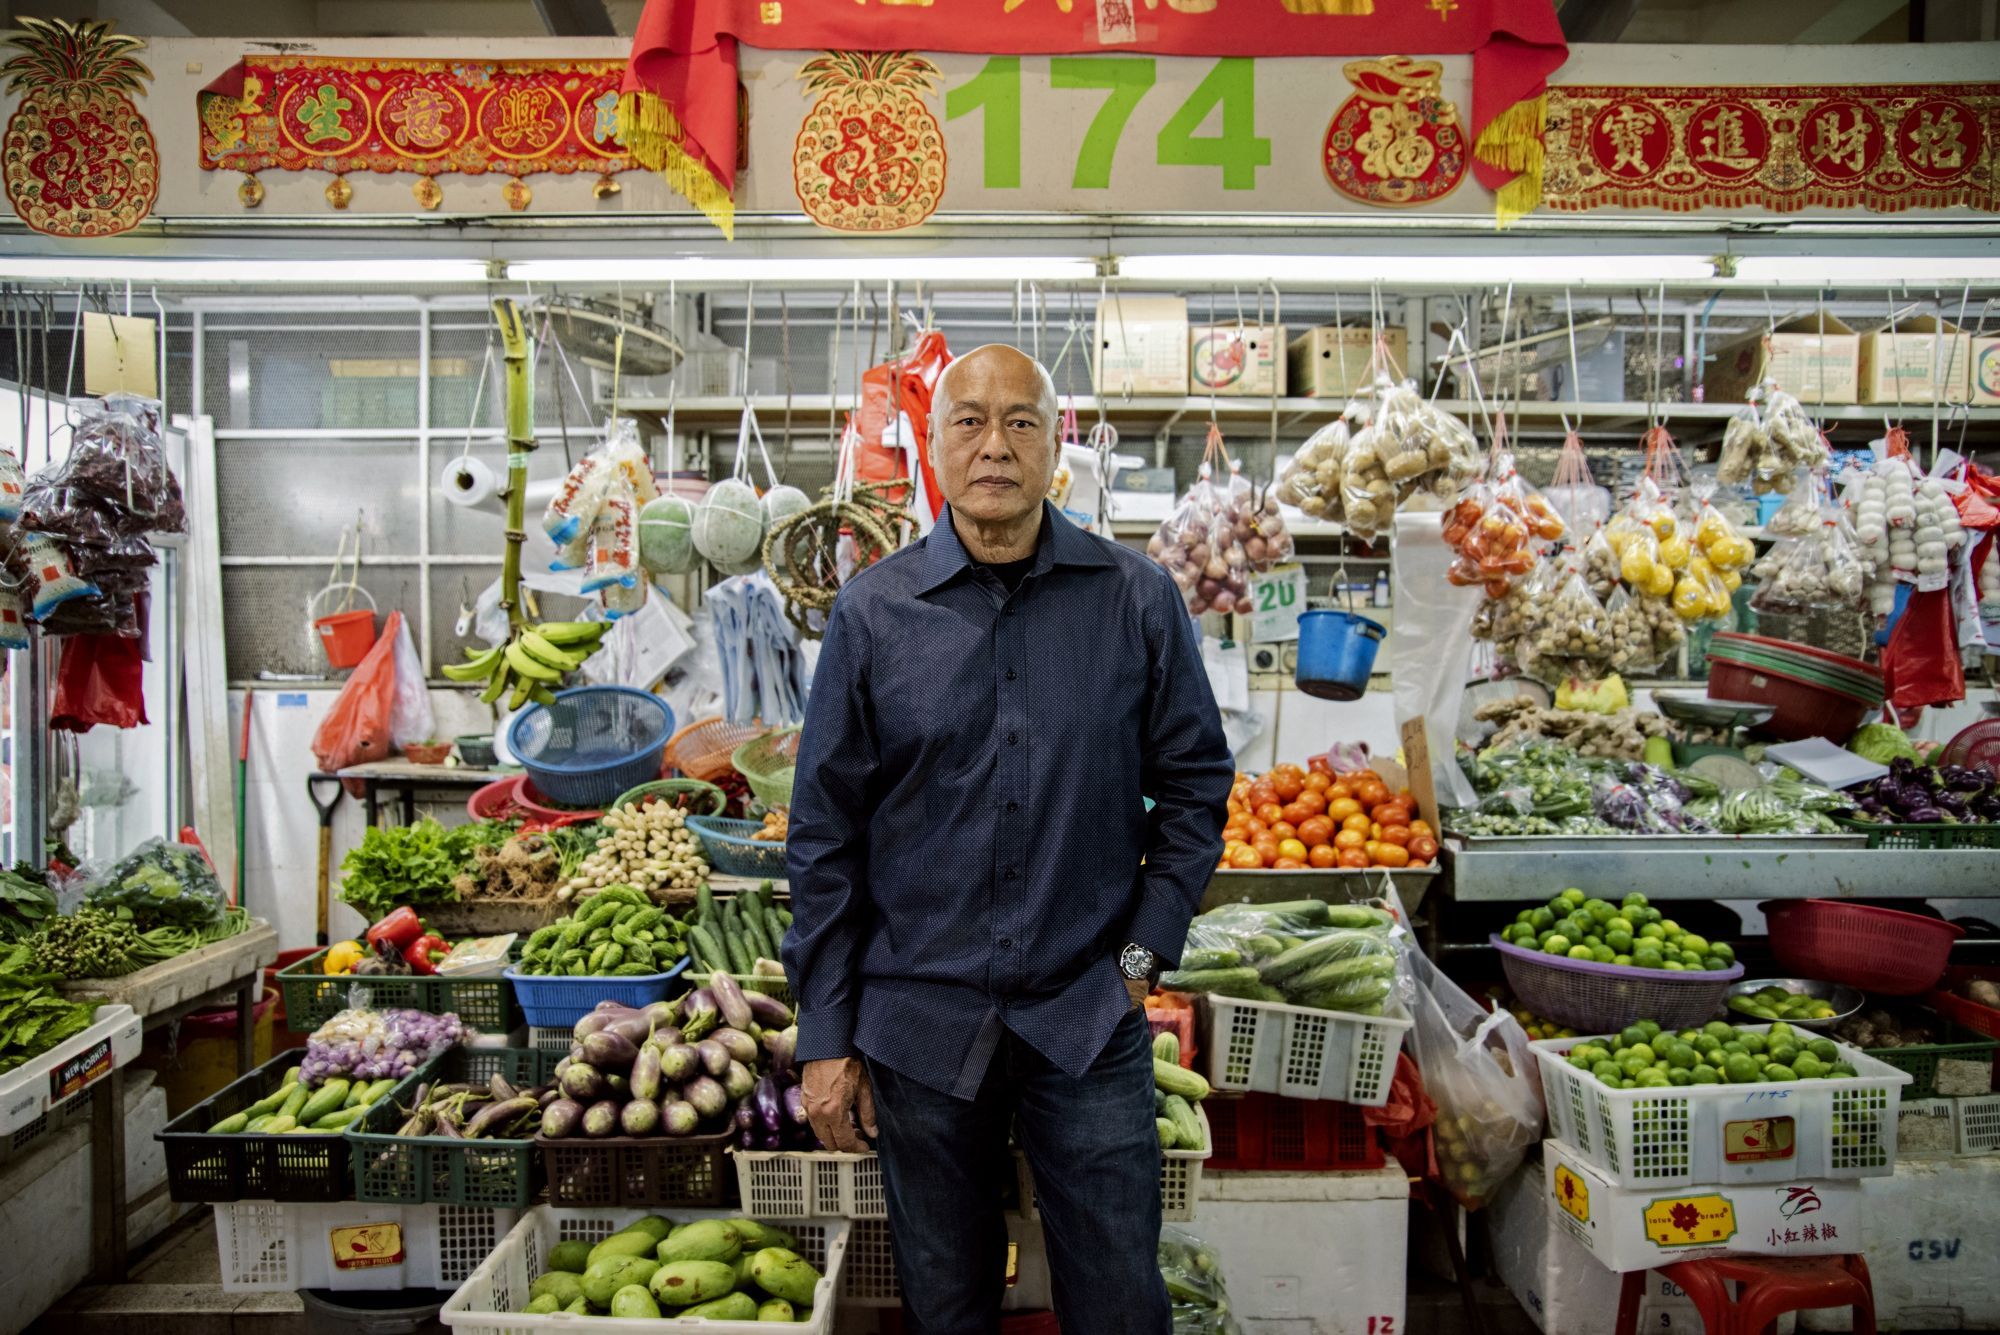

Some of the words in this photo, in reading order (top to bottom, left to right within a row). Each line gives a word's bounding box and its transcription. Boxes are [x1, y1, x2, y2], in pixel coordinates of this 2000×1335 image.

[946, 55, 1271, 190] 174
[64, 1061, 81, 1082] NEW
[80, 1043, 108, 1073] YORKER
[1661, 1312, 1671, 1328] 3
